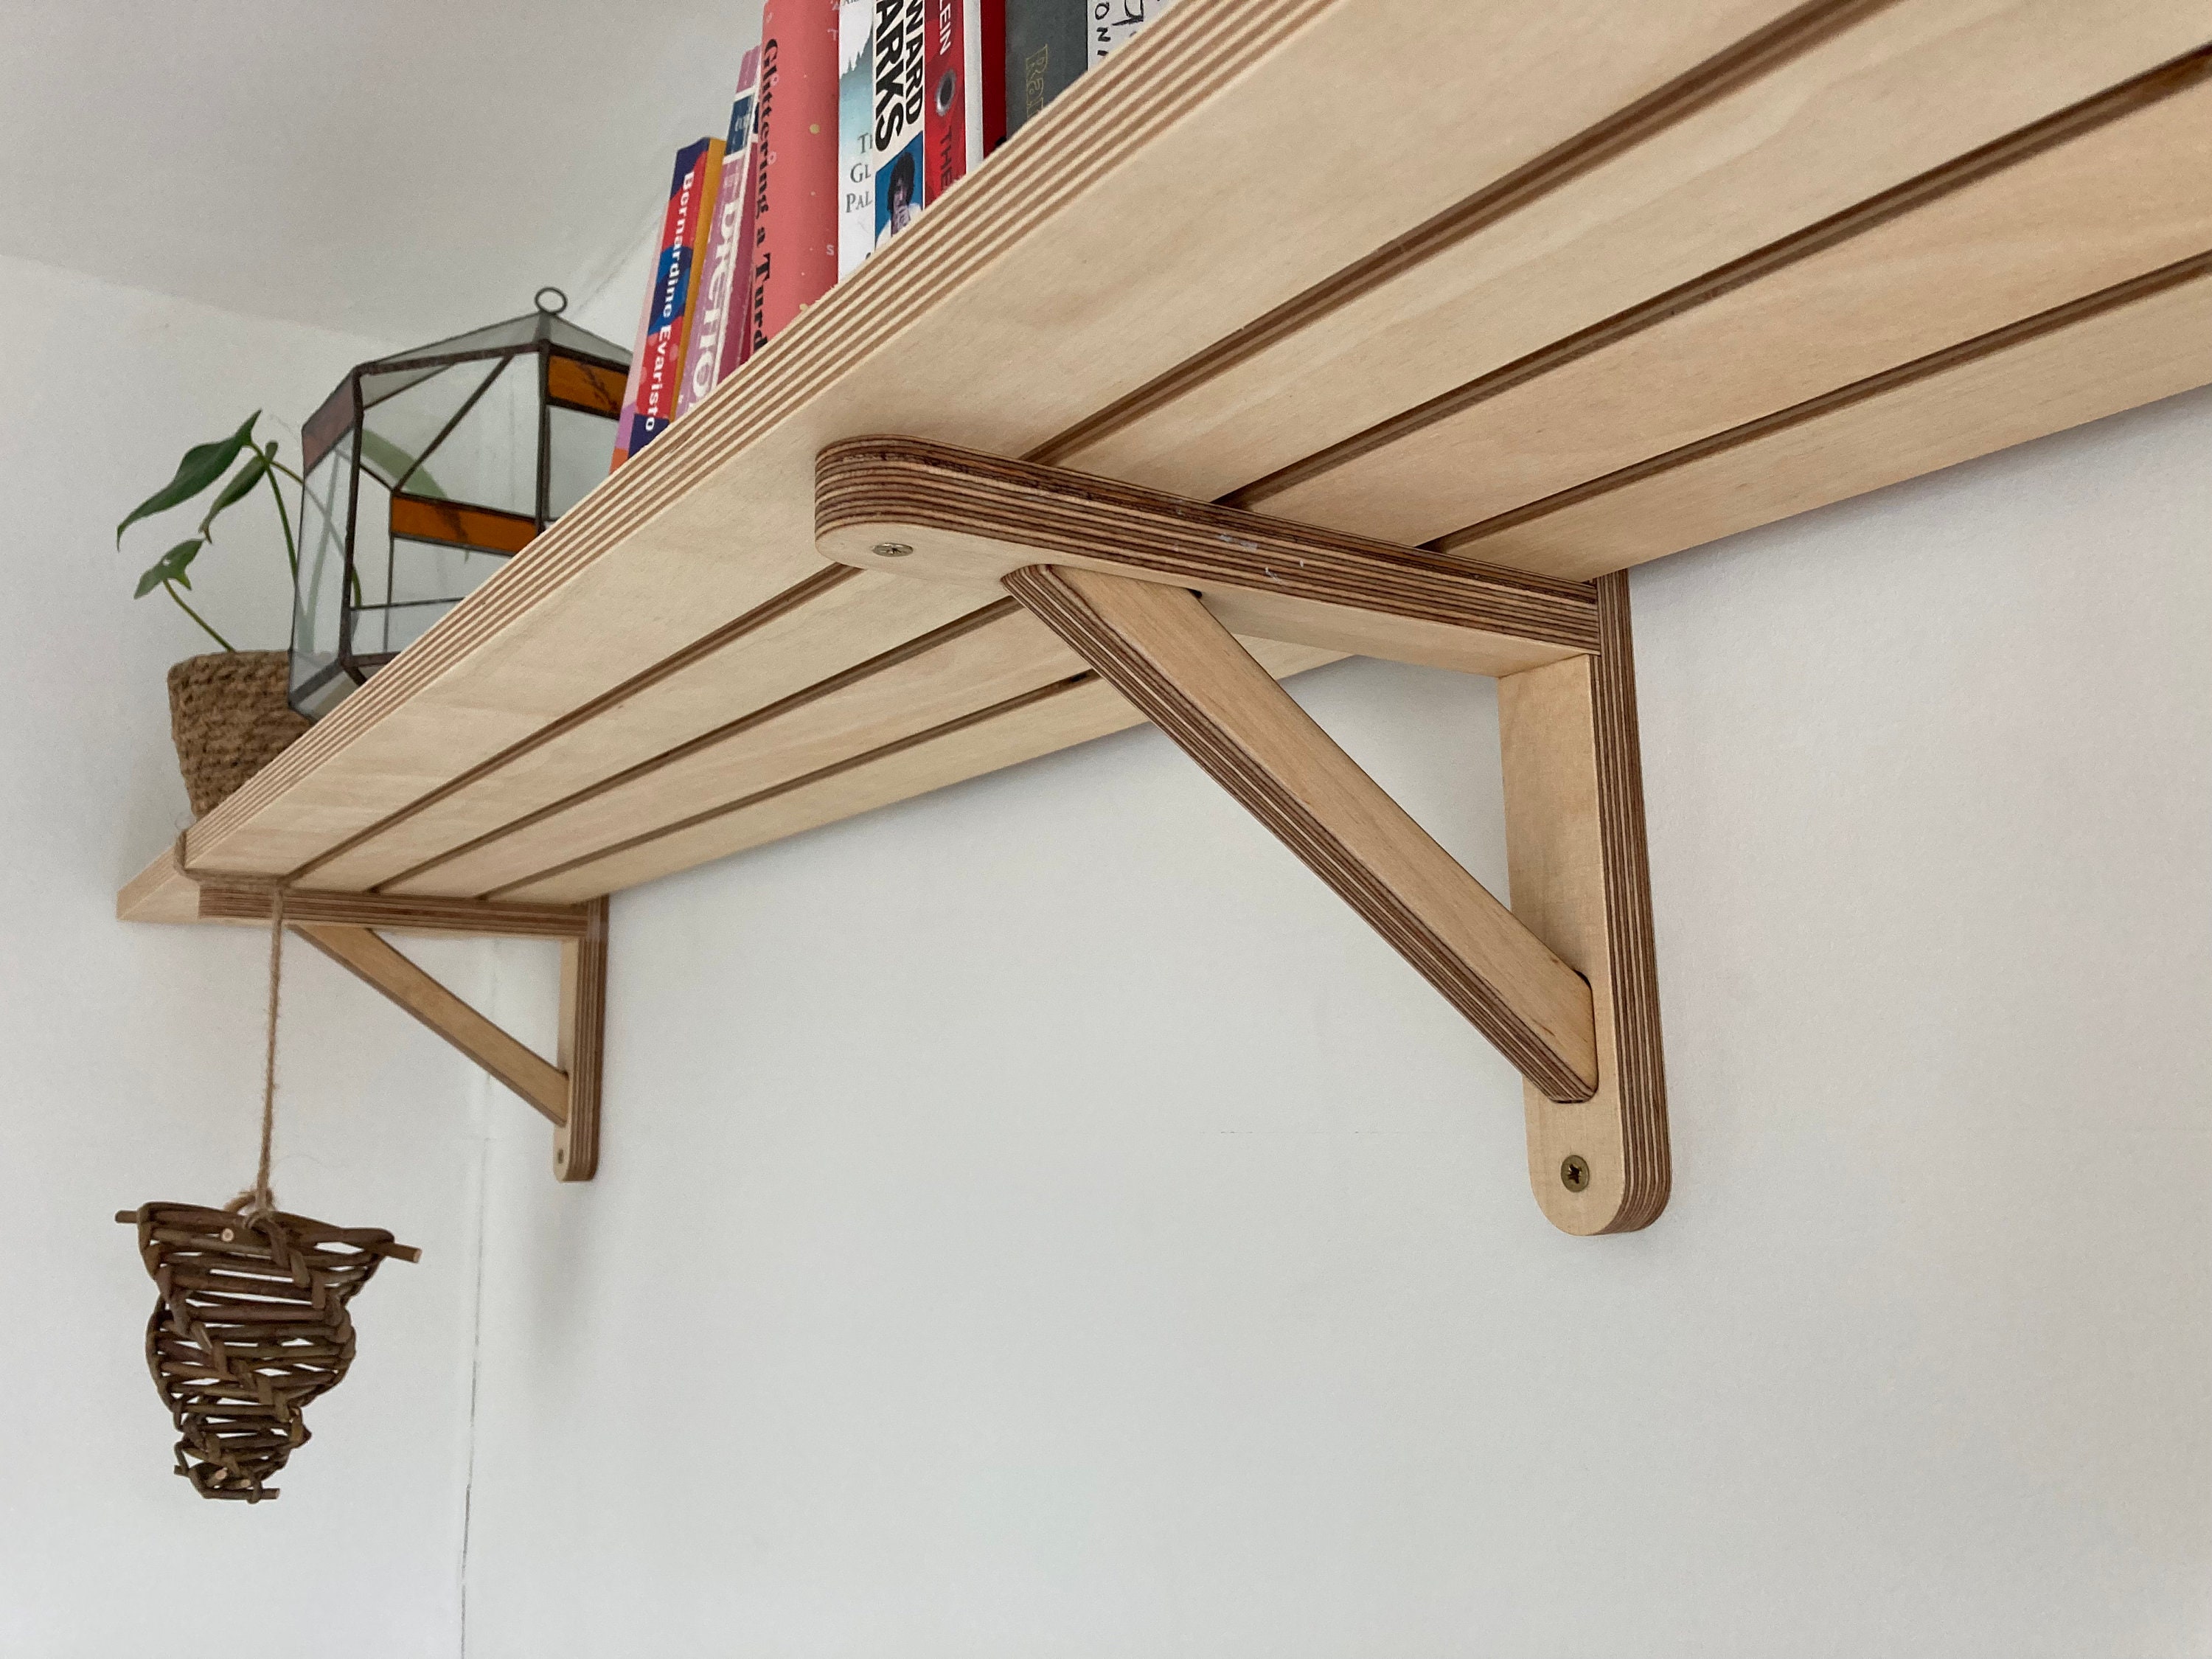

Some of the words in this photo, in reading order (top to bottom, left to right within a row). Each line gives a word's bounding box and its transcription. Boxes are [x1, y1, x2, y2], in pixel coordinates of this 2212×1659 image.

[875, 0, 903, 151] ARKS
[905, 0, 923, 125] WARD
[757, 39, 779, 220] Glittering
[662, 171, 695, 319] Bernardine
[757, 227, 765, 247] a
[753, 252, 772, 352] Turd
[645, 323, 672, 431] Evaristo
